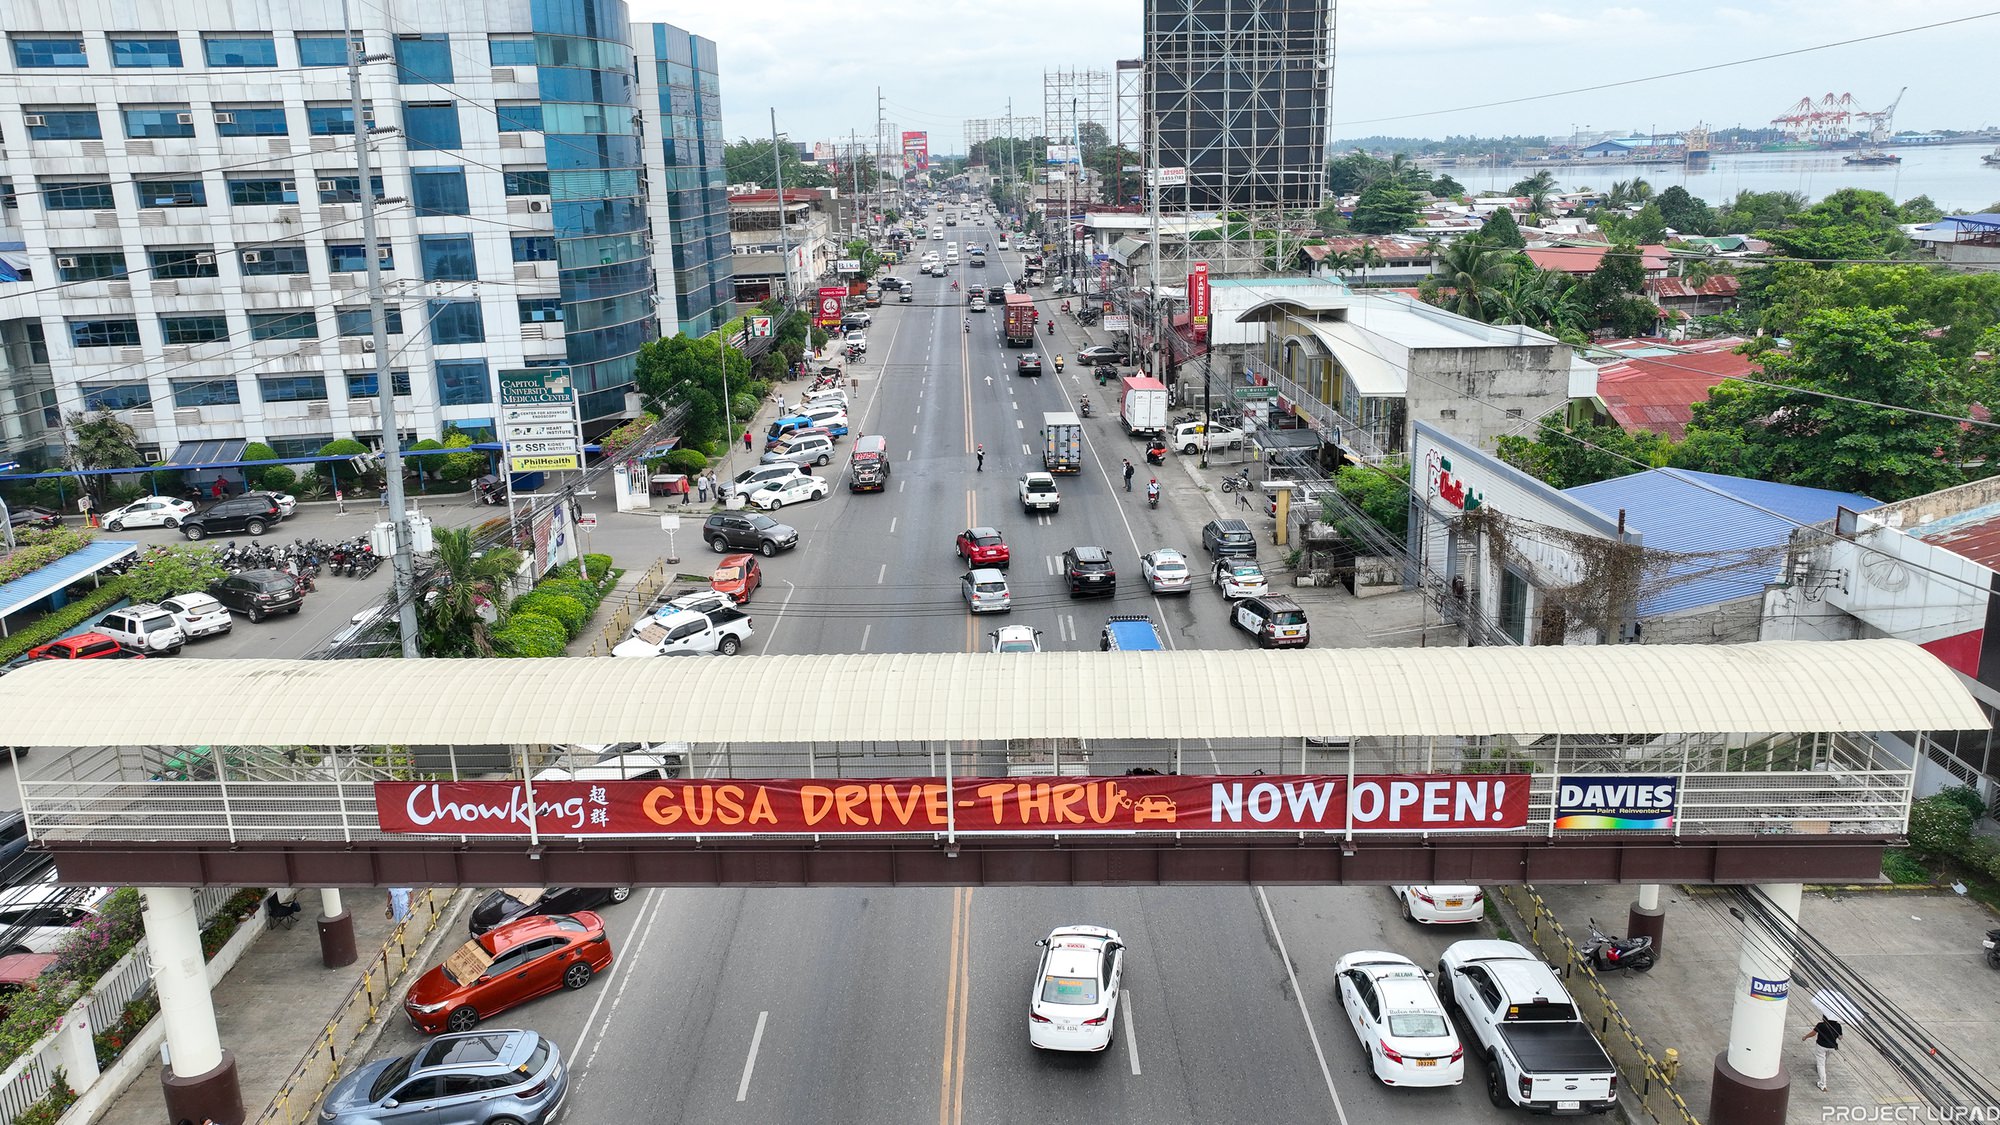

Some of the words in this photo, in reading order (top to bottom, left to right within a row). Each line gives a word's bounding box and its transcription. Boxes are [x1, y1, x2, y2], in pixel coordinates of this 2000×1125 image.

[502, 387, 549, 395] UNIVERSITY
[525, 443, 546, 452] SSR
[406, 784, 585, 828] Chowking
[642, 785, 778, 825] GUSA
[800, 782, 1118, 826] DRIVE-THRU
[1211, 782, 1335, 823] NOW
[1352, 781, 1506, 822] OPEN!
[1560, 785, 1672, 808] DAVIES
